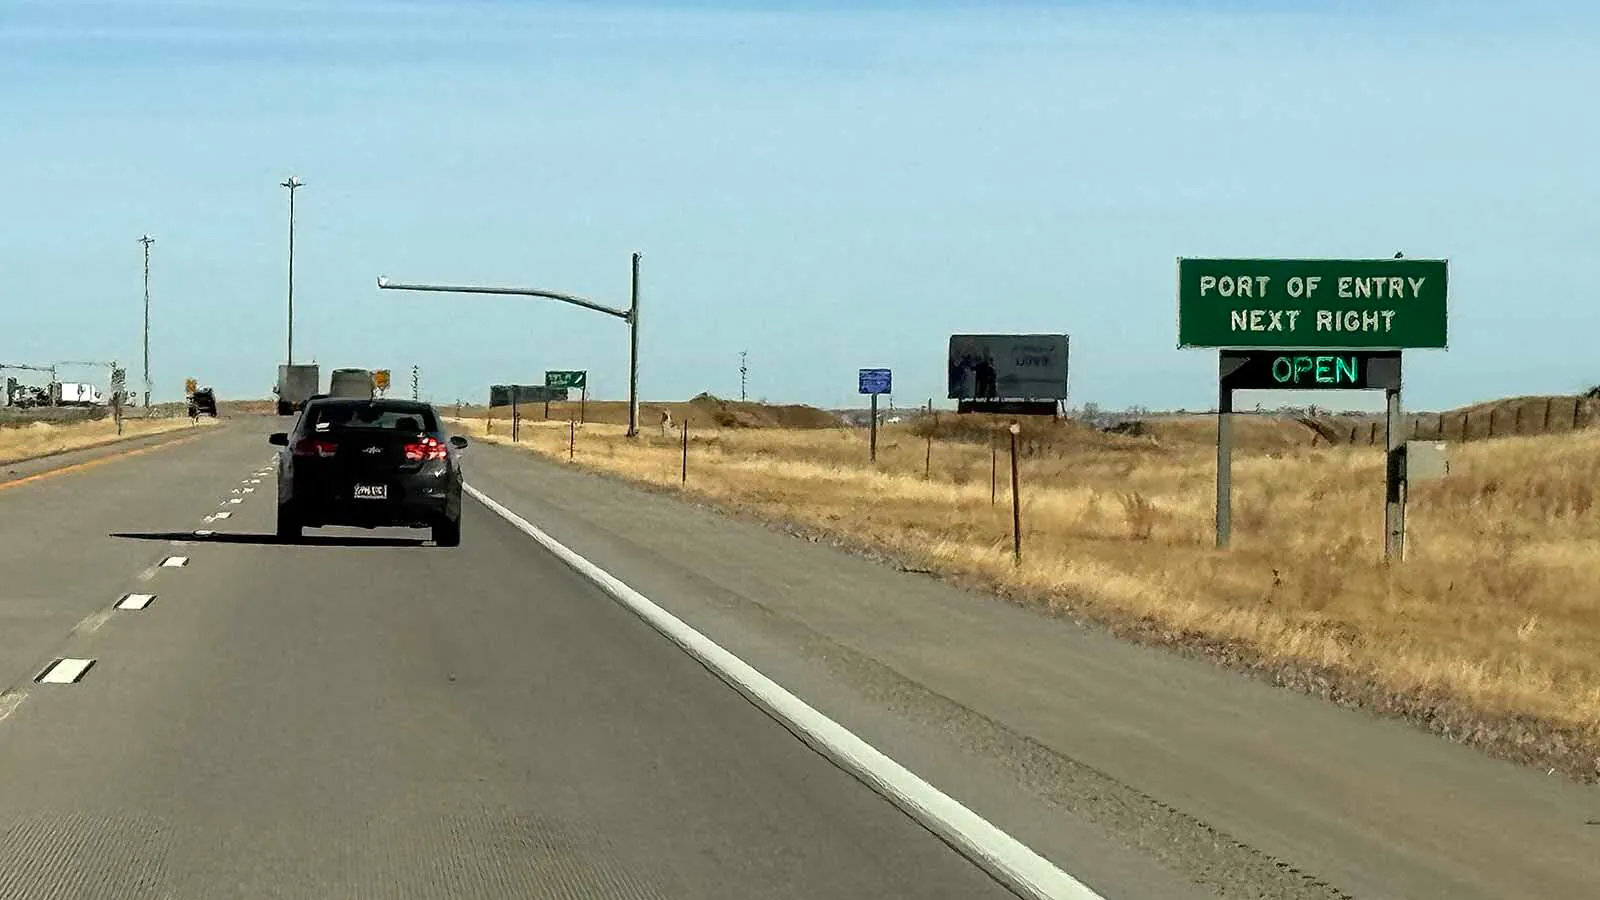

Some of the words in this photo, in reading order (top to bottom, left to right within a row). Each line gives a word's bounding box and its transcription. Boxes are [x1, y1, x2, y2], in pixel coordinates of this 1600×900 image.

[1200, 275, 1271, 298] PORT
[1287, 275, 1321, 298] OF
[1338, 275, 1426, 299] ENTRY
[1231, 309, 1301, 332] NEXT
[1316, 309, 1396, 333] RIGHT
[1271, 356, 1358, 384] OPEN
